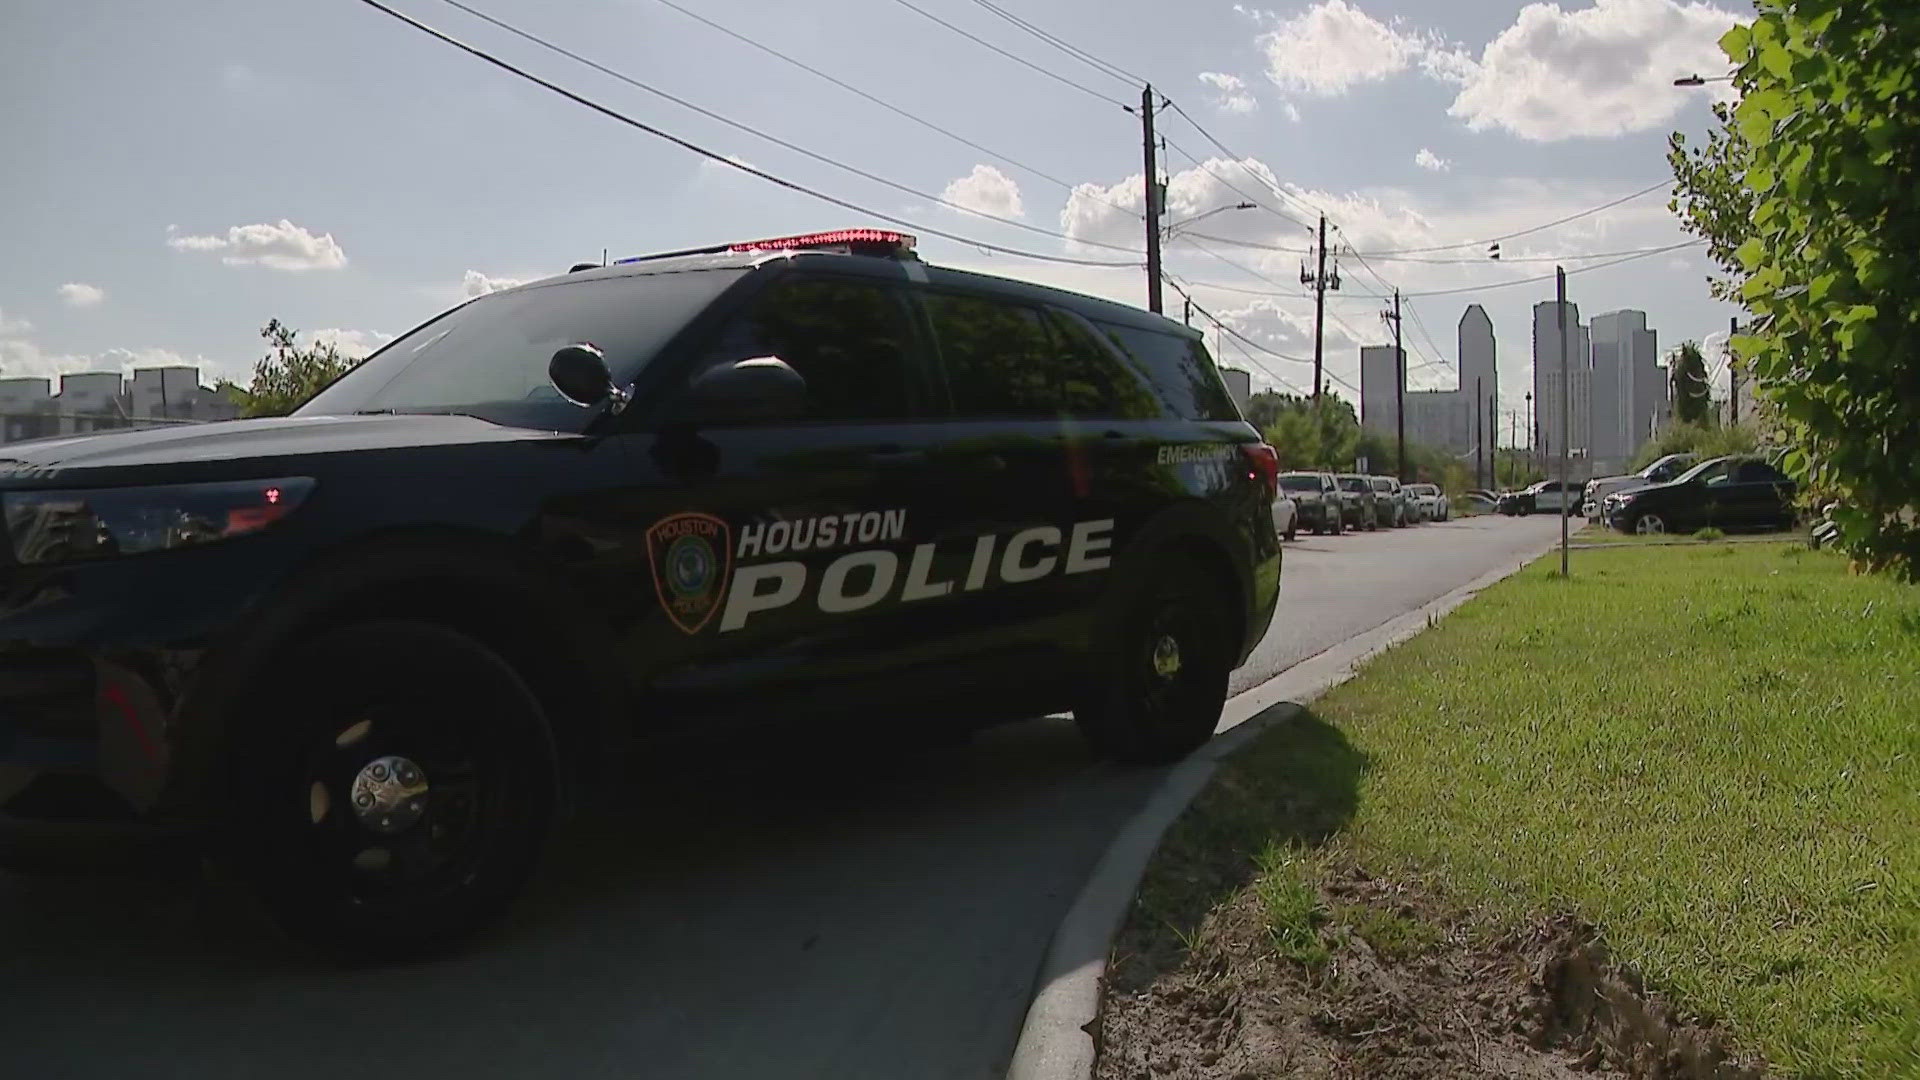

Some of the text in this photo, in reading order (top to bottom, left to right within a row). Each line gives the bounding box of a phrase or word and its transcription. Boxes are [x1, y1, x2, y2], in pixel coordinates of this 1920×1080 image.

[657, 519, 718, 541] HOUSTON
[737, 509, 905, 558] HOUSTON
[719, 518, 1114, 633] POLICE
